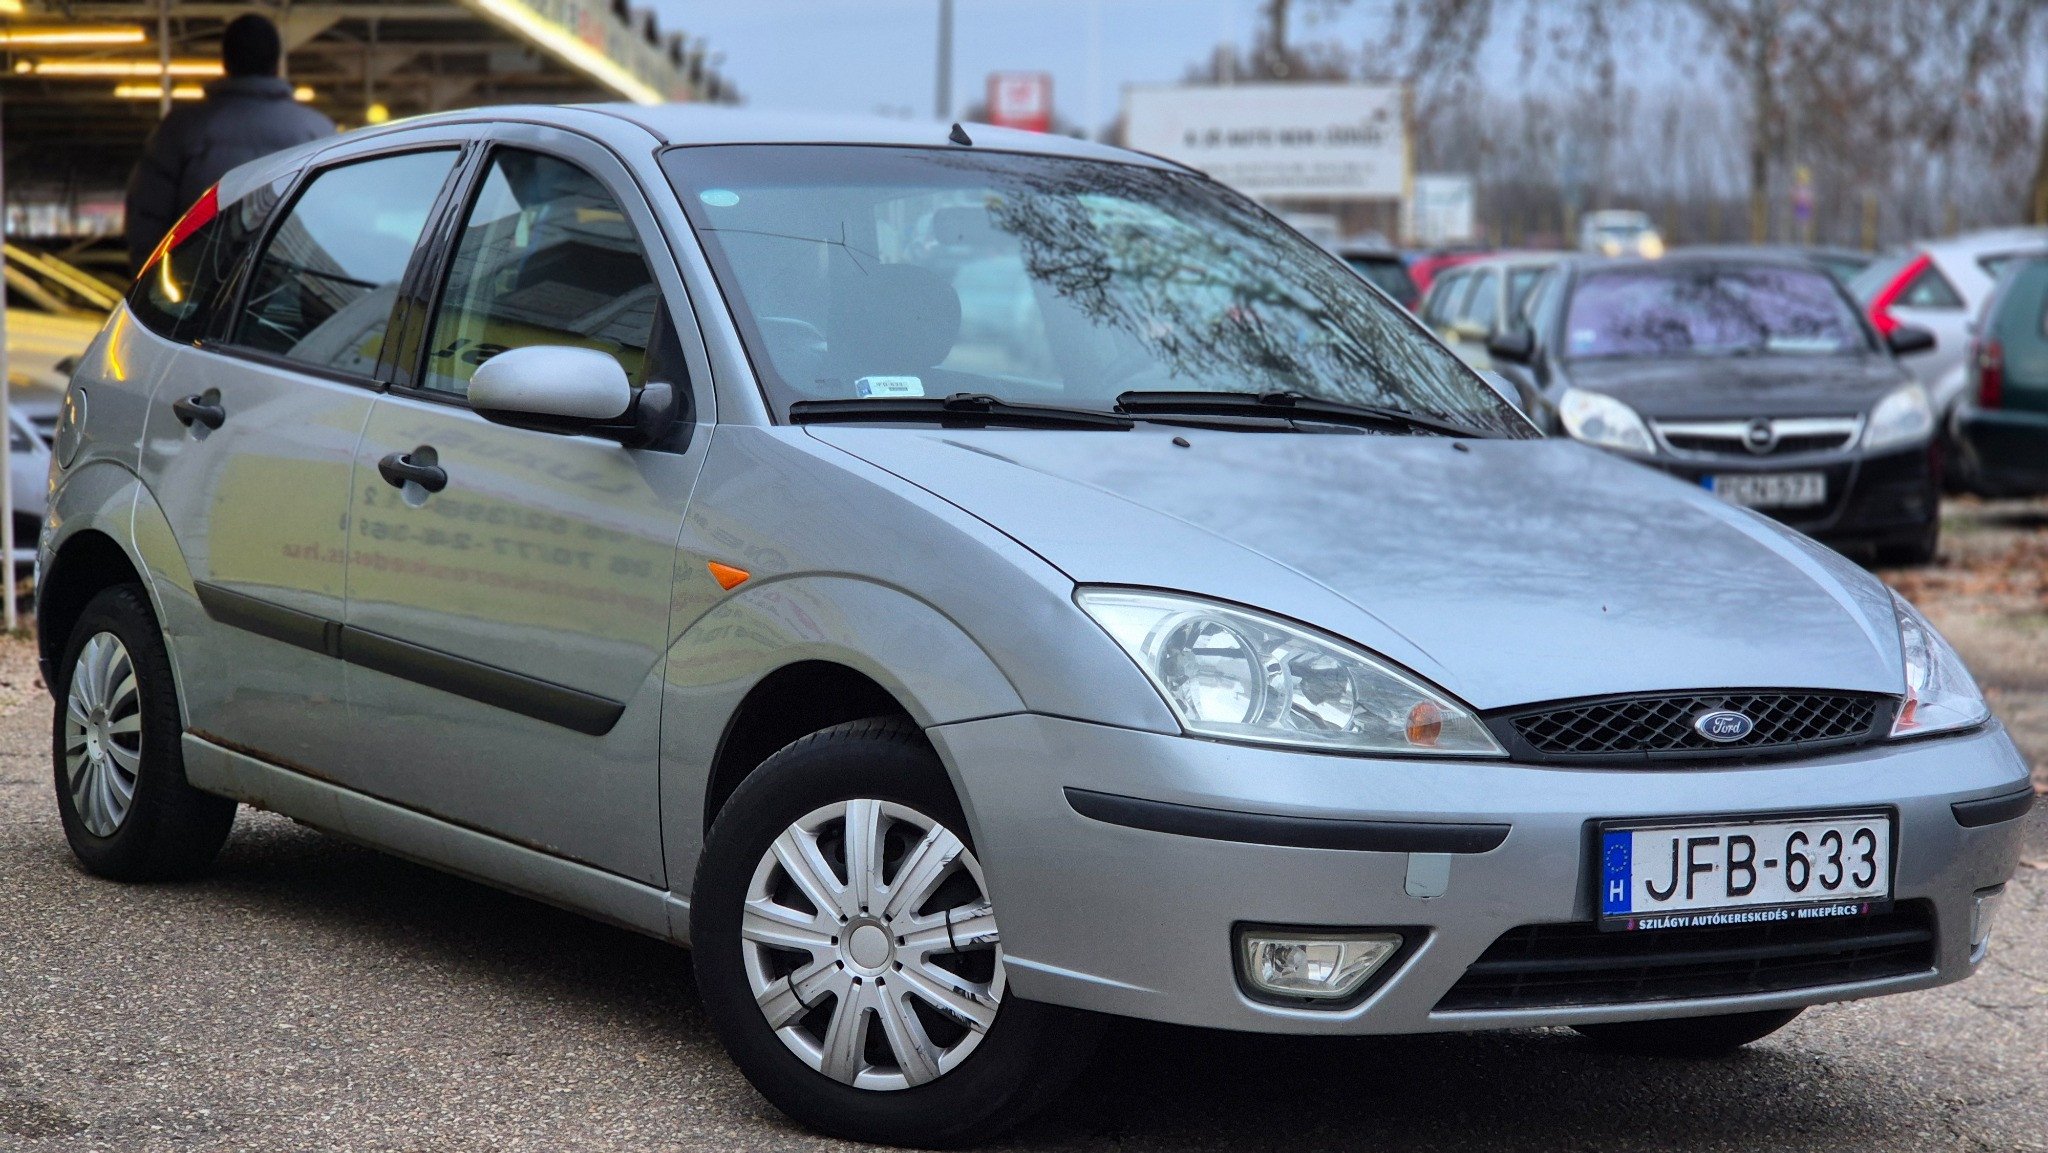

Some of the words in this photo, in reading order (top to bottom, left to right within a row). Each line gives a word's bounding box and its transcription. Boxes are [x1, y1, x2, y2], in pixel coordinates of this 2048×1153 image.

[1712, 717, 1742, 734] Ford
[1609, 879, 1624, 903] H
[1645, 827, 1877, 901] JFB-633
[1638, 916, 1690, 930] SZILÁGYI
[1691, 908, 1788, 926] AUTÓKERESKEDÉS
[1797, 904, 1858, 918] MIKEPÉRCS
